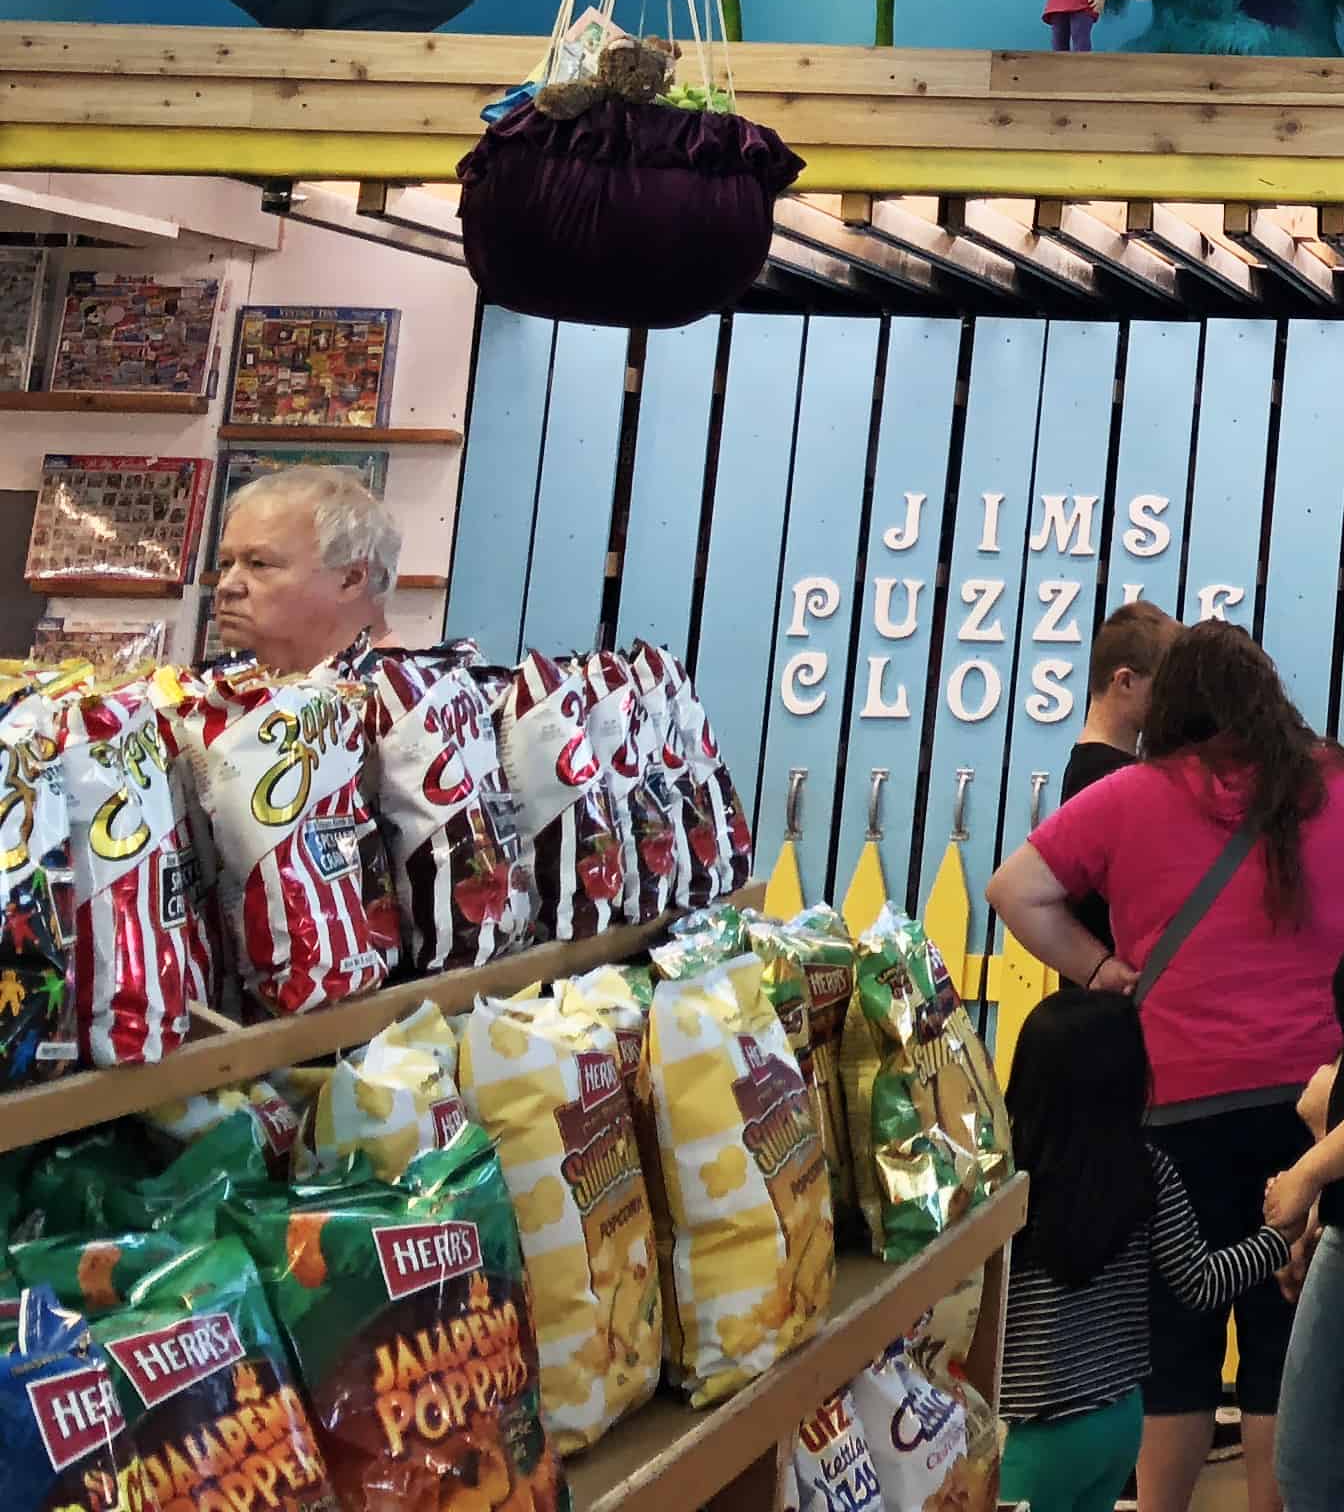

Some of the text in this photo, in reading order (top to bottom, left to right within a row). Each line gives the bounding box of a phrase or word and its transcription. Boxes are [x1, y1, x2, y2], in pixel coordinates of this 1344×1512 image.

[882, 492, 1171, 558] JIMS
[780, 652, 1075, 724] CLOS
[134, 1320, 232, 1382] HERR'S
[51, 1379, 123, 1440] HER
